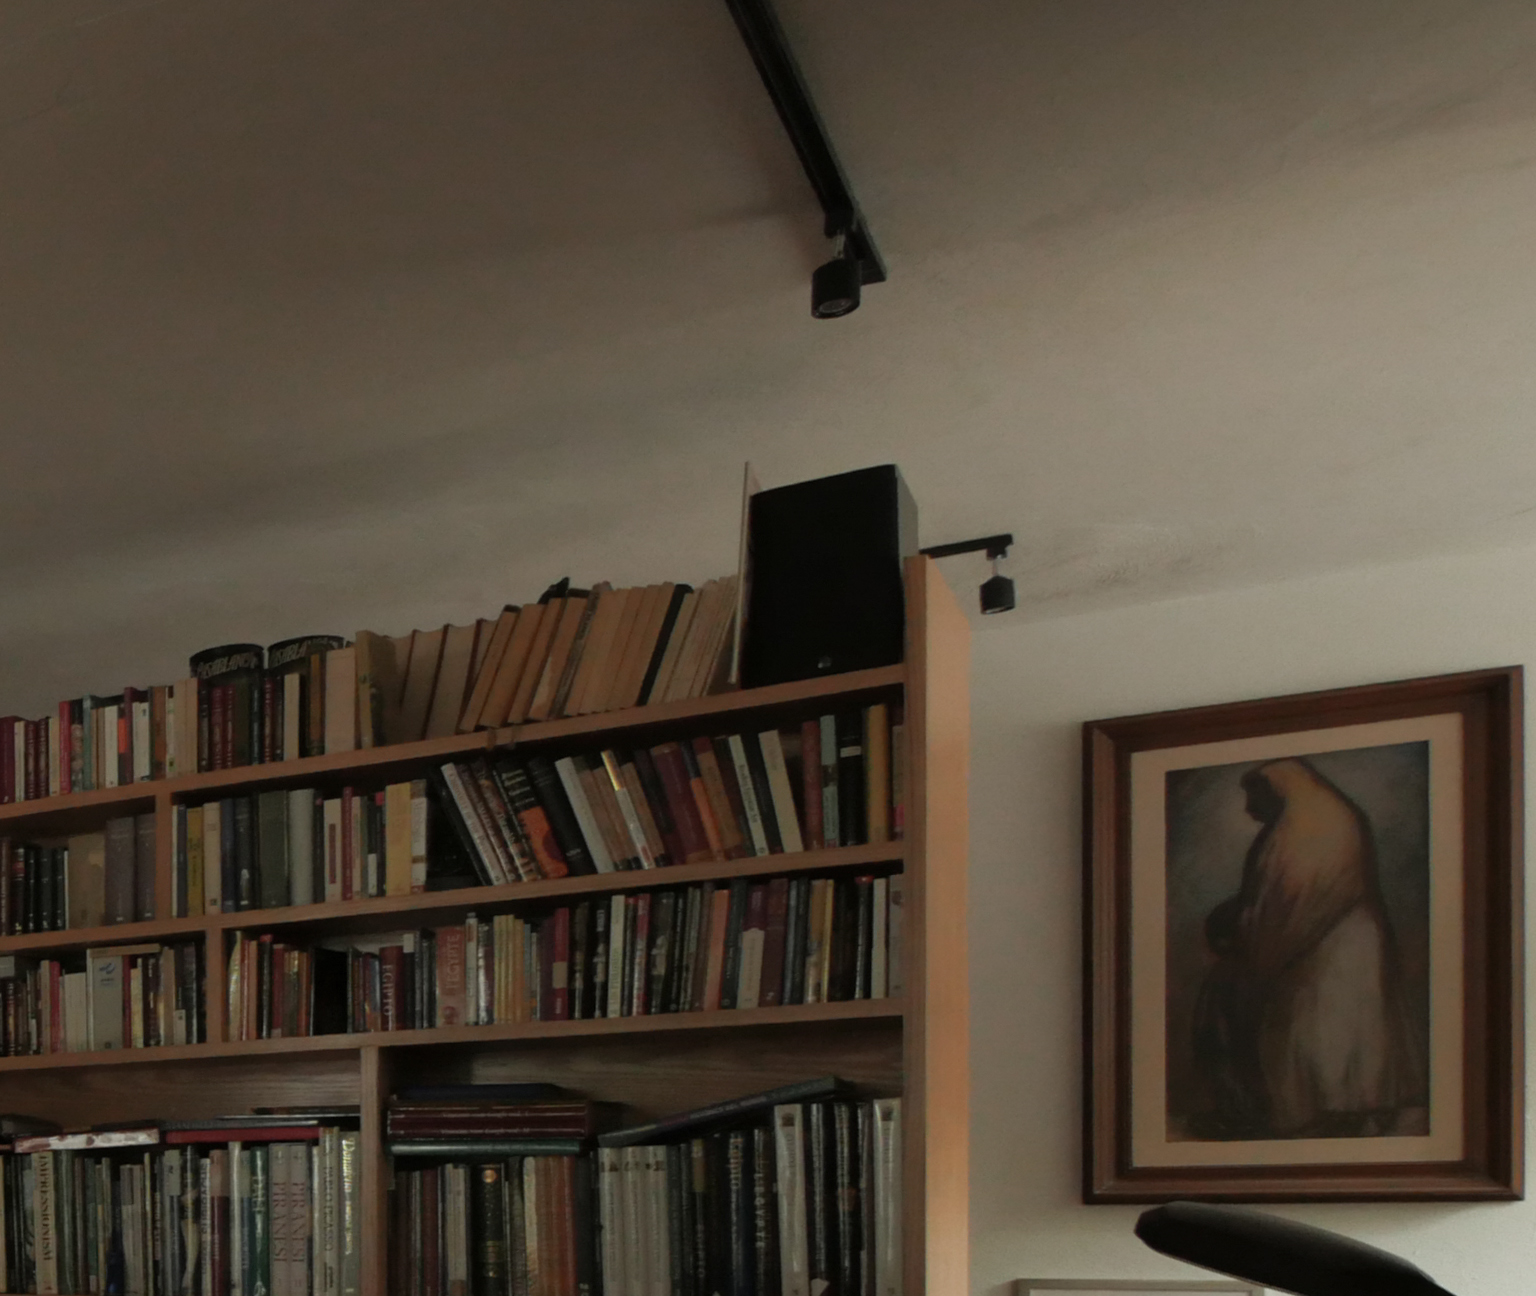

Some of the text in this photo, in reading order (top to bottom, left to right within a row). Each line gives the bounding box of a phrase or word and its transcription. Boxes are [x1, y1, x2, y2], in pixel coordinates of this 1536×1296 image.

[381, 964, 394, 1016] EGIPTO
[38, 1155, 53, 1261] IMPRESSIONISM
[273, 1181, 287, 1263] PIRANESI
[292, 1181, 305, 1263] PIRANESI
